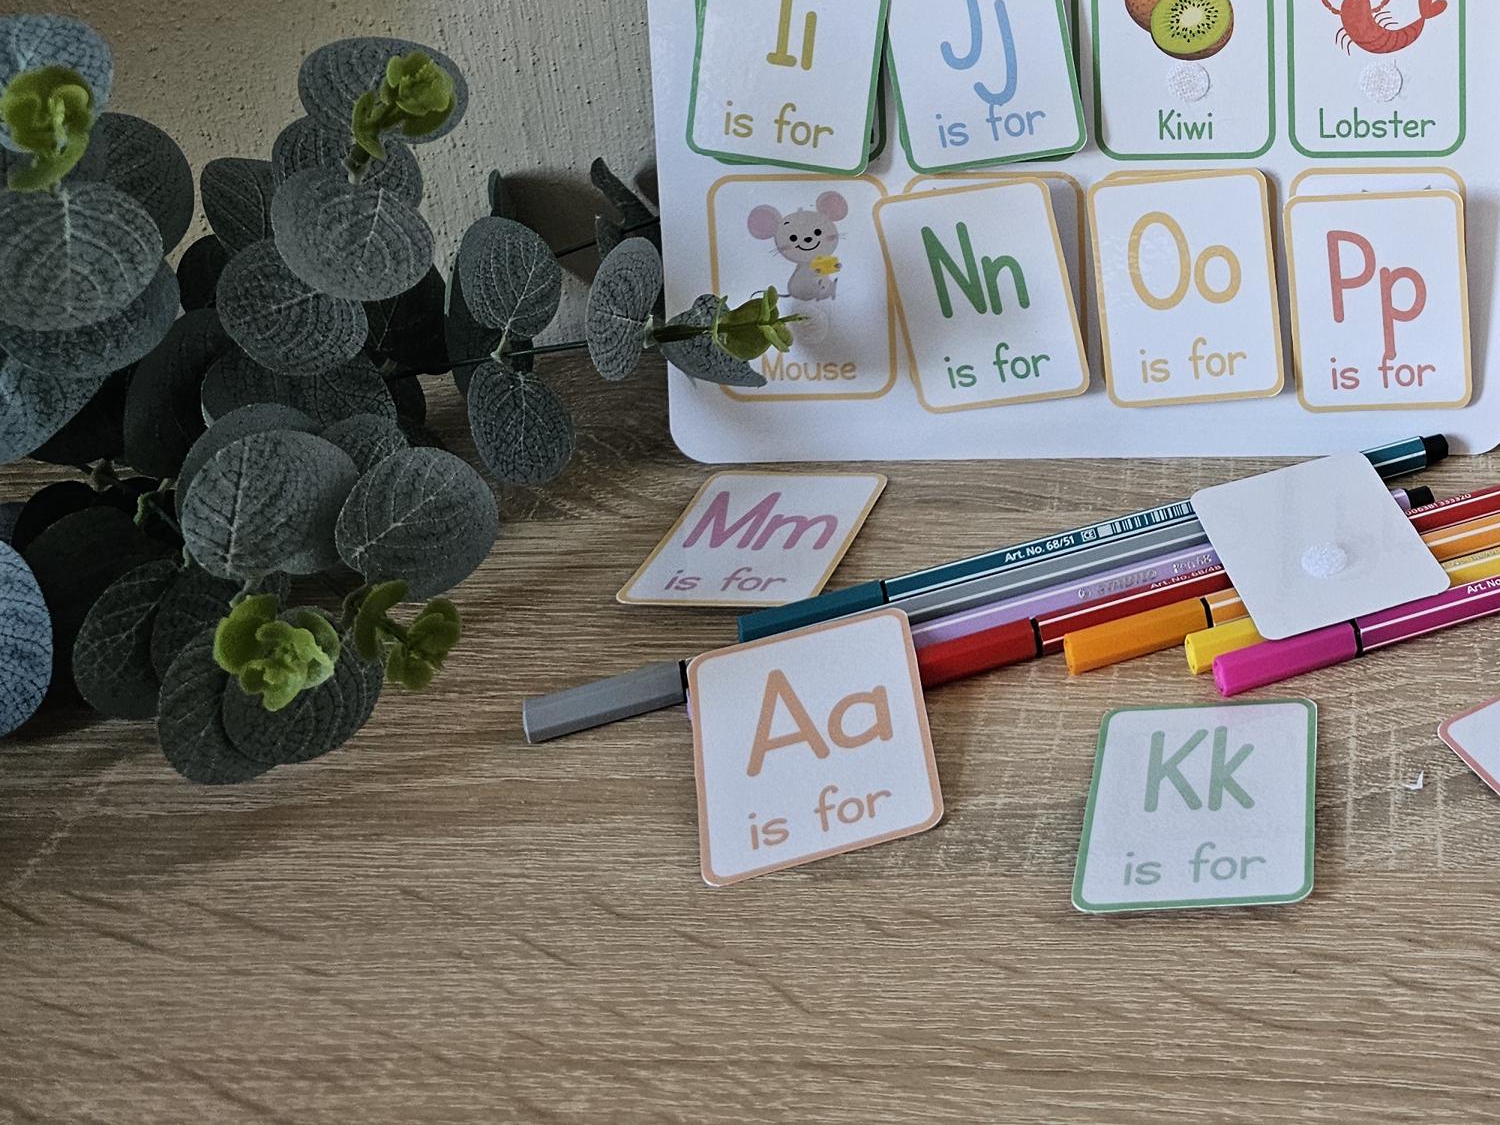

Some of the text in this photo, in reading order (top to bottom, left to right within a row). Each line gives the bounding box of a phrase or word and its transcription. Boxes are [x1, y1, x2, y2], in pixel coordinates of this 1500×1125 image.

[724, 101, 834, 148] is for
[936, 93, 1045, 148] is for
[1159, 109, 1212, 140] Kiwi
[1319, 107, 1436, 138] Lobster
[921, 222, 1030, 318] Nn
[1128, 211, 1241, 310] Oo
[1327, 230, 1427, 360] Pp
[762, 355, 857, 383] Mouse
[944, 342, 1050, 389] is for
[1140, 337, 1247, 383] is for
[1331, 349, 1436, 390] is for
[681, 492, 838, 552] Mm
[1004, 550, 1025, 563] Art.
[1026, 545, 1045, 557] No.
[1046, 534, 1075, 551] 68/51
[664, 567, 787, 594] is for
[1149, 577, 1171, 589] Art.
[1171, 573, 1190, 584] No.
[1466, 583, 1487, 594] Art.
[747, 669, 893, 777] Aa
[1144, 726, 1255, 812] Kk
[749, 785, 892, 850] is for
[1124, 842, 1266, 885] is for
